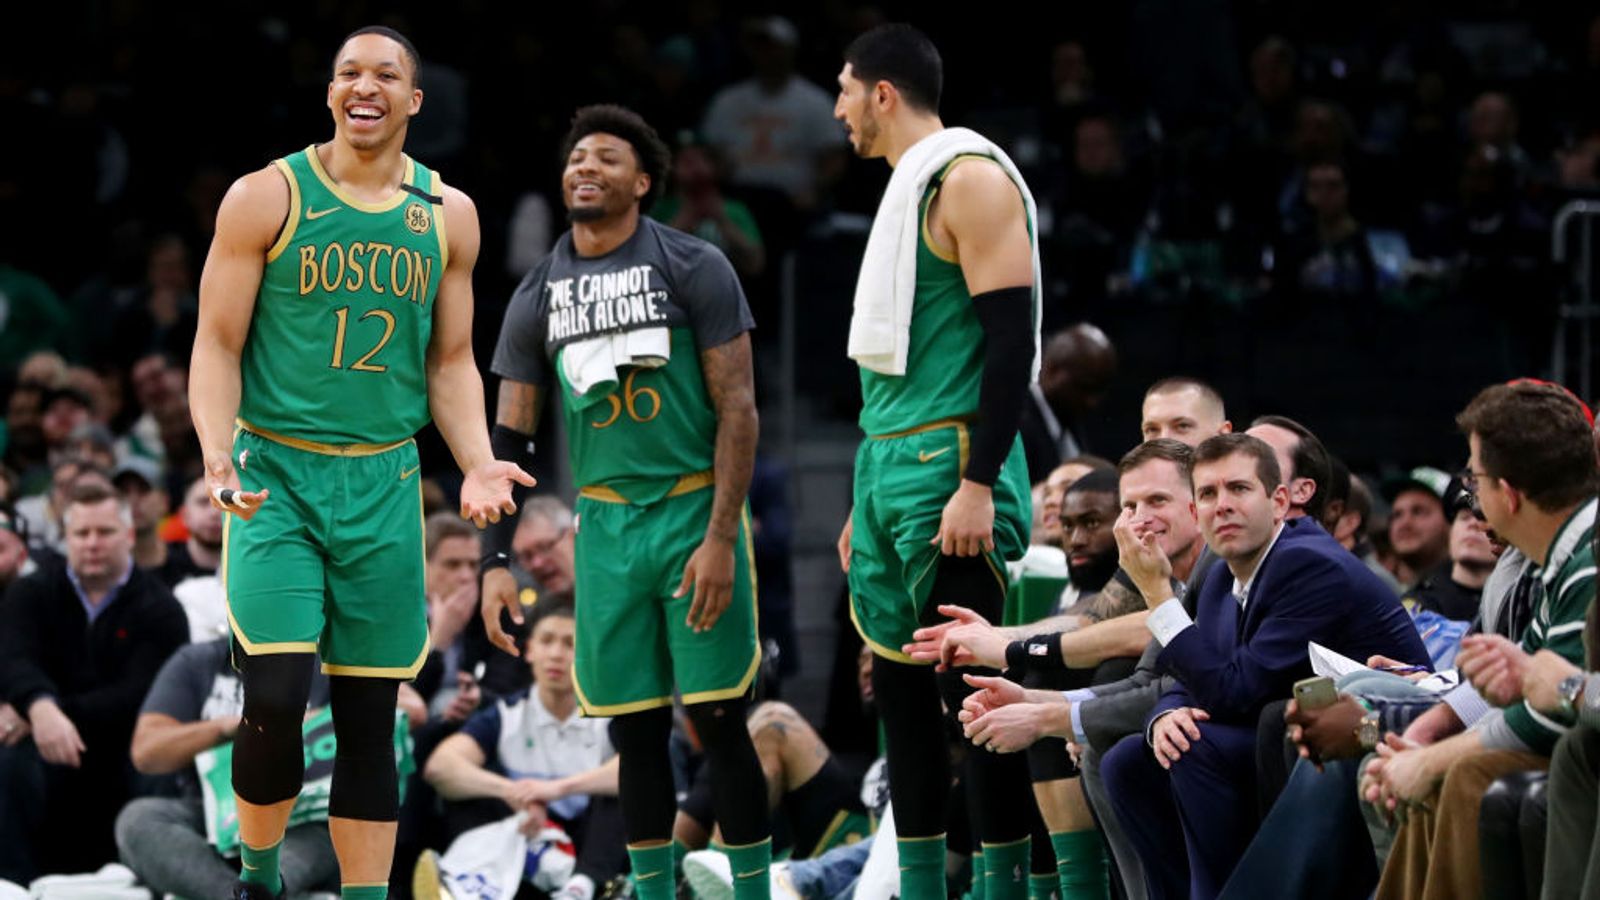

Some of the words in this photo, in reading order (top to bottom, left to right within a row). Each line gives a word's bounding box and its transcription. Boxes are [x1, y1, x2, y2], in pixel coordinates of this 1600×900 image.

[298, 240, 432, 306] BOSTON
[578, 265, 652, 304] CANNOT
[328, 305, 396, 373] 12
[548, 303, 591, 342] WALK
